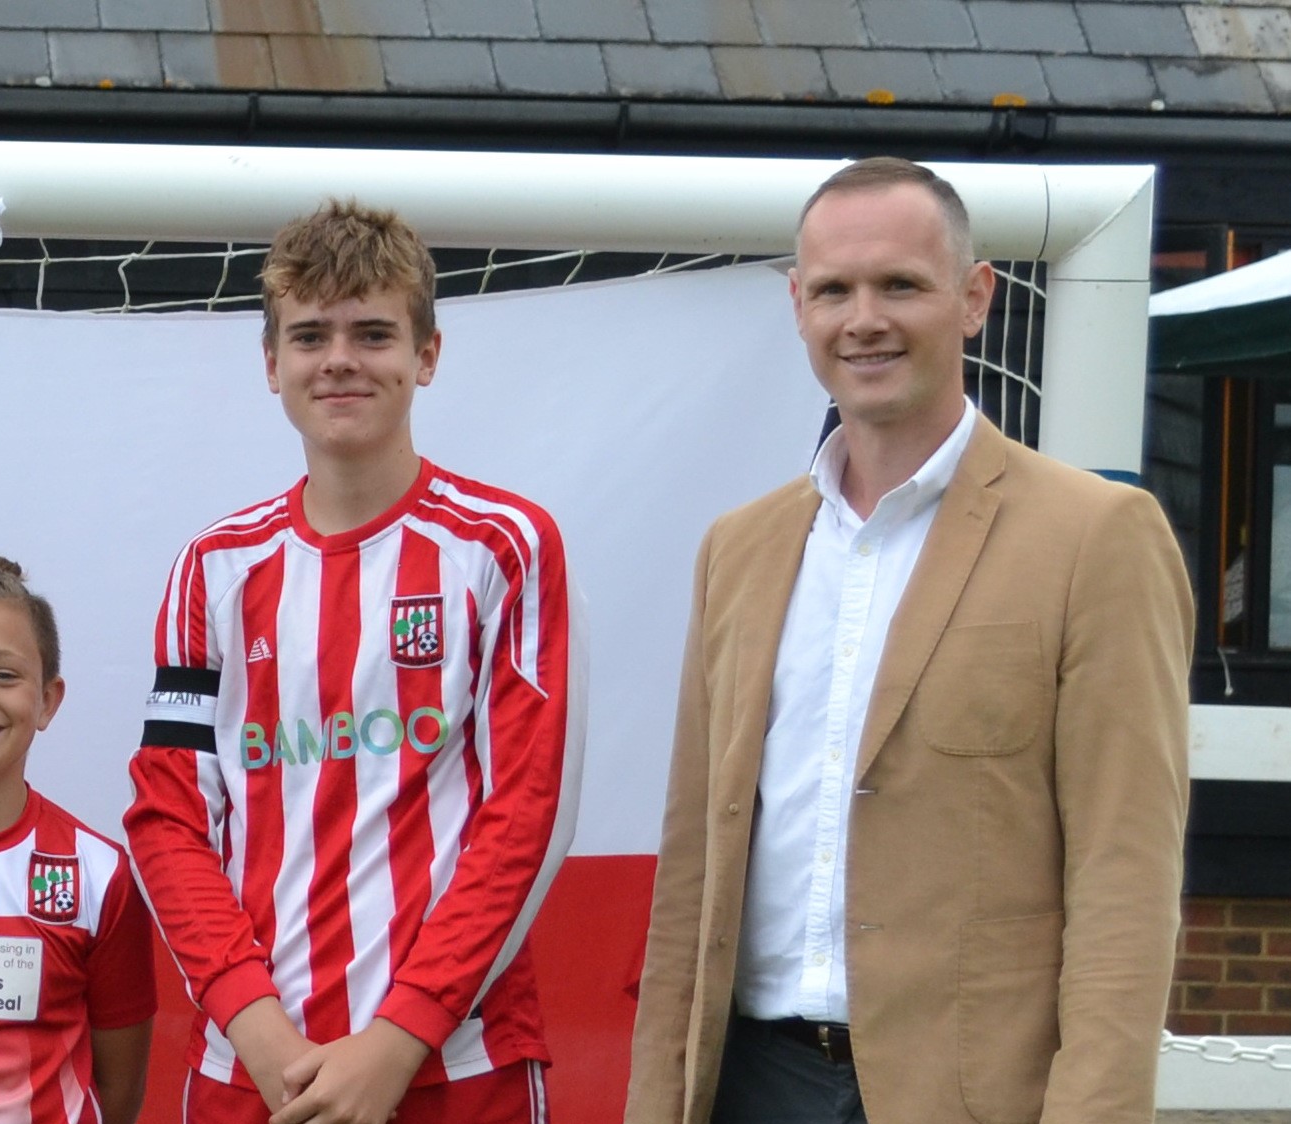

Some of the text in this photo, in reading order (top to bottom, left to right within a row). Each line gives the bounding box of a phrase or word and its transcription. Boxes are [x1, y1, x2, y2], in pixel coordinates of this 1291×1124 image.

[240, 706, 449, 769] BAMBOO
[25, 943, 35, 955] in
[3, 958, 15, 968] of
[17, 958, 34, 969] the
